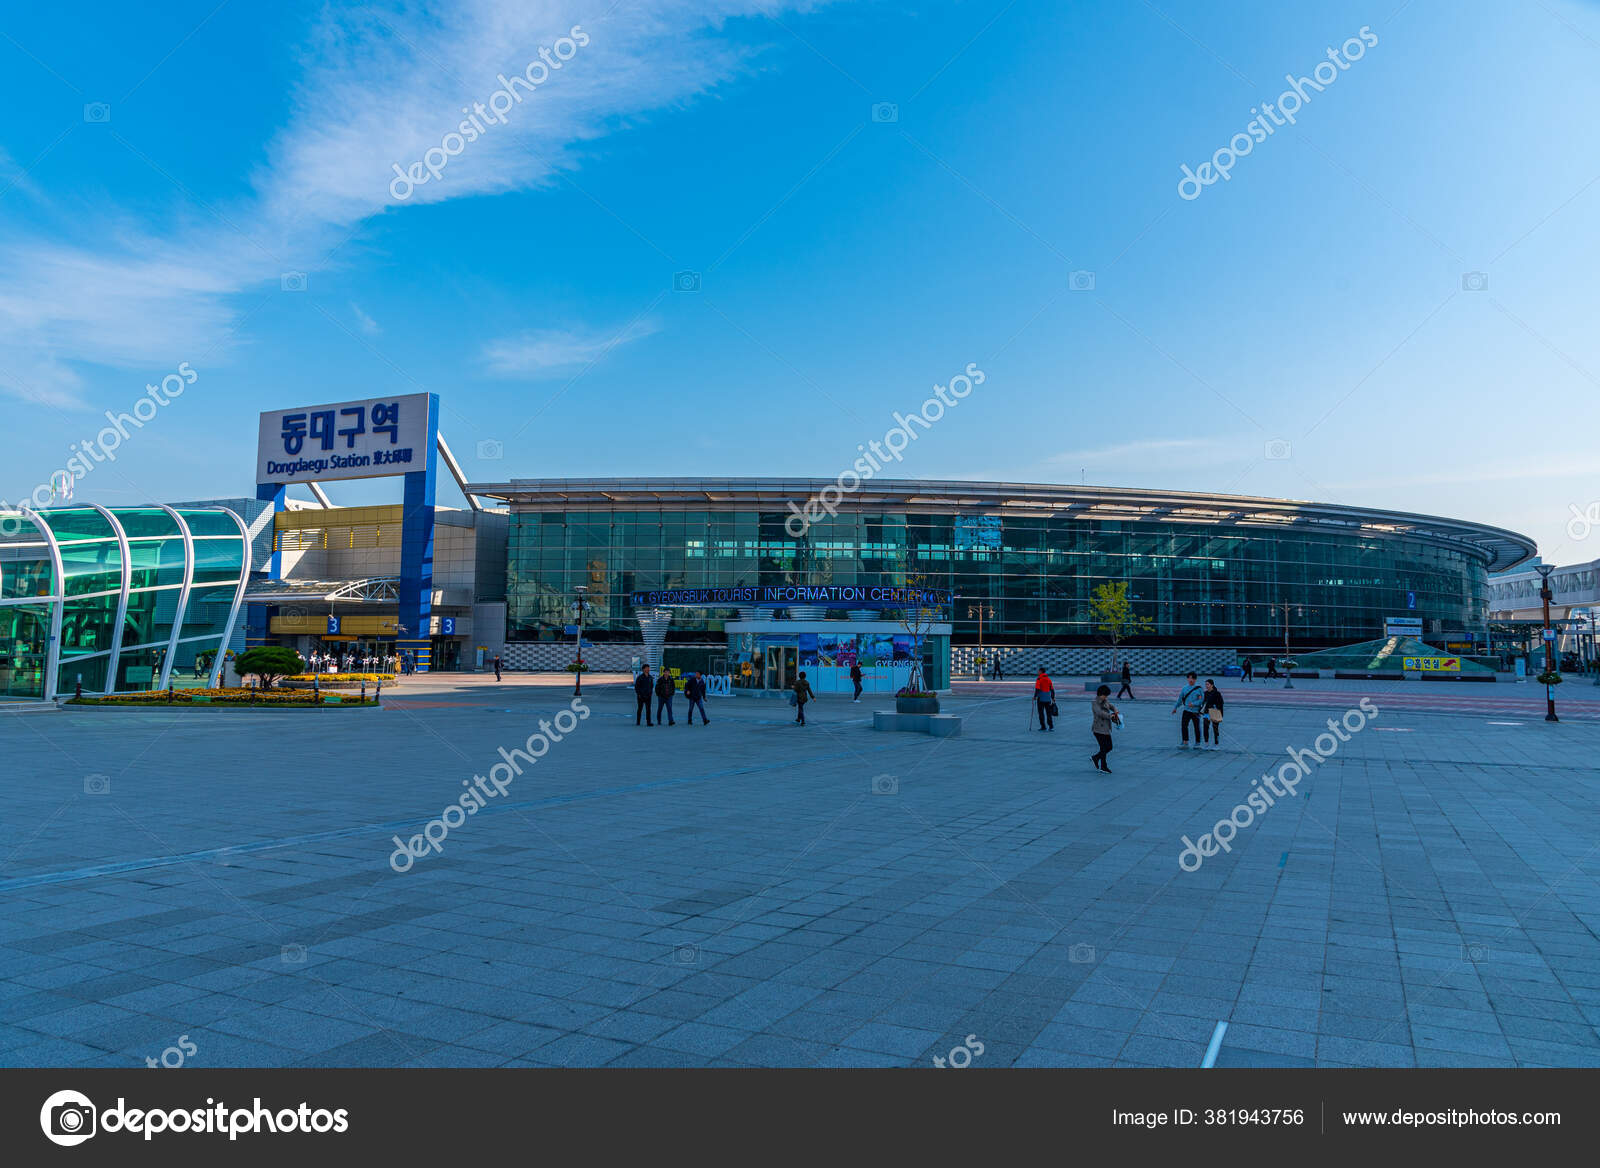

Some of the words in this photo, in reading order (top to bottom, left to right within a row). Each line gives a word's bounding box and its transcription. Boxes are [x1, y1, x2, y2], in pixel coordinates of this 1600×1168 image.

[280, 402, 400, 455] 동대구역
[266, 456, 328, 476] Dongdaegu
[330, 452, 370, 469] Station
[648, 589, 710, 604] GYEONGBUK
[712, 588, 759, 602] TOURIST
[764, 587, 865, 601] INFORMATION
[870, 587, 923, 602] CENTER
[1409, 592, 1415, 608] 2
[330, 617, 338, 632] 3
[445, 618, 452, 633] 3
